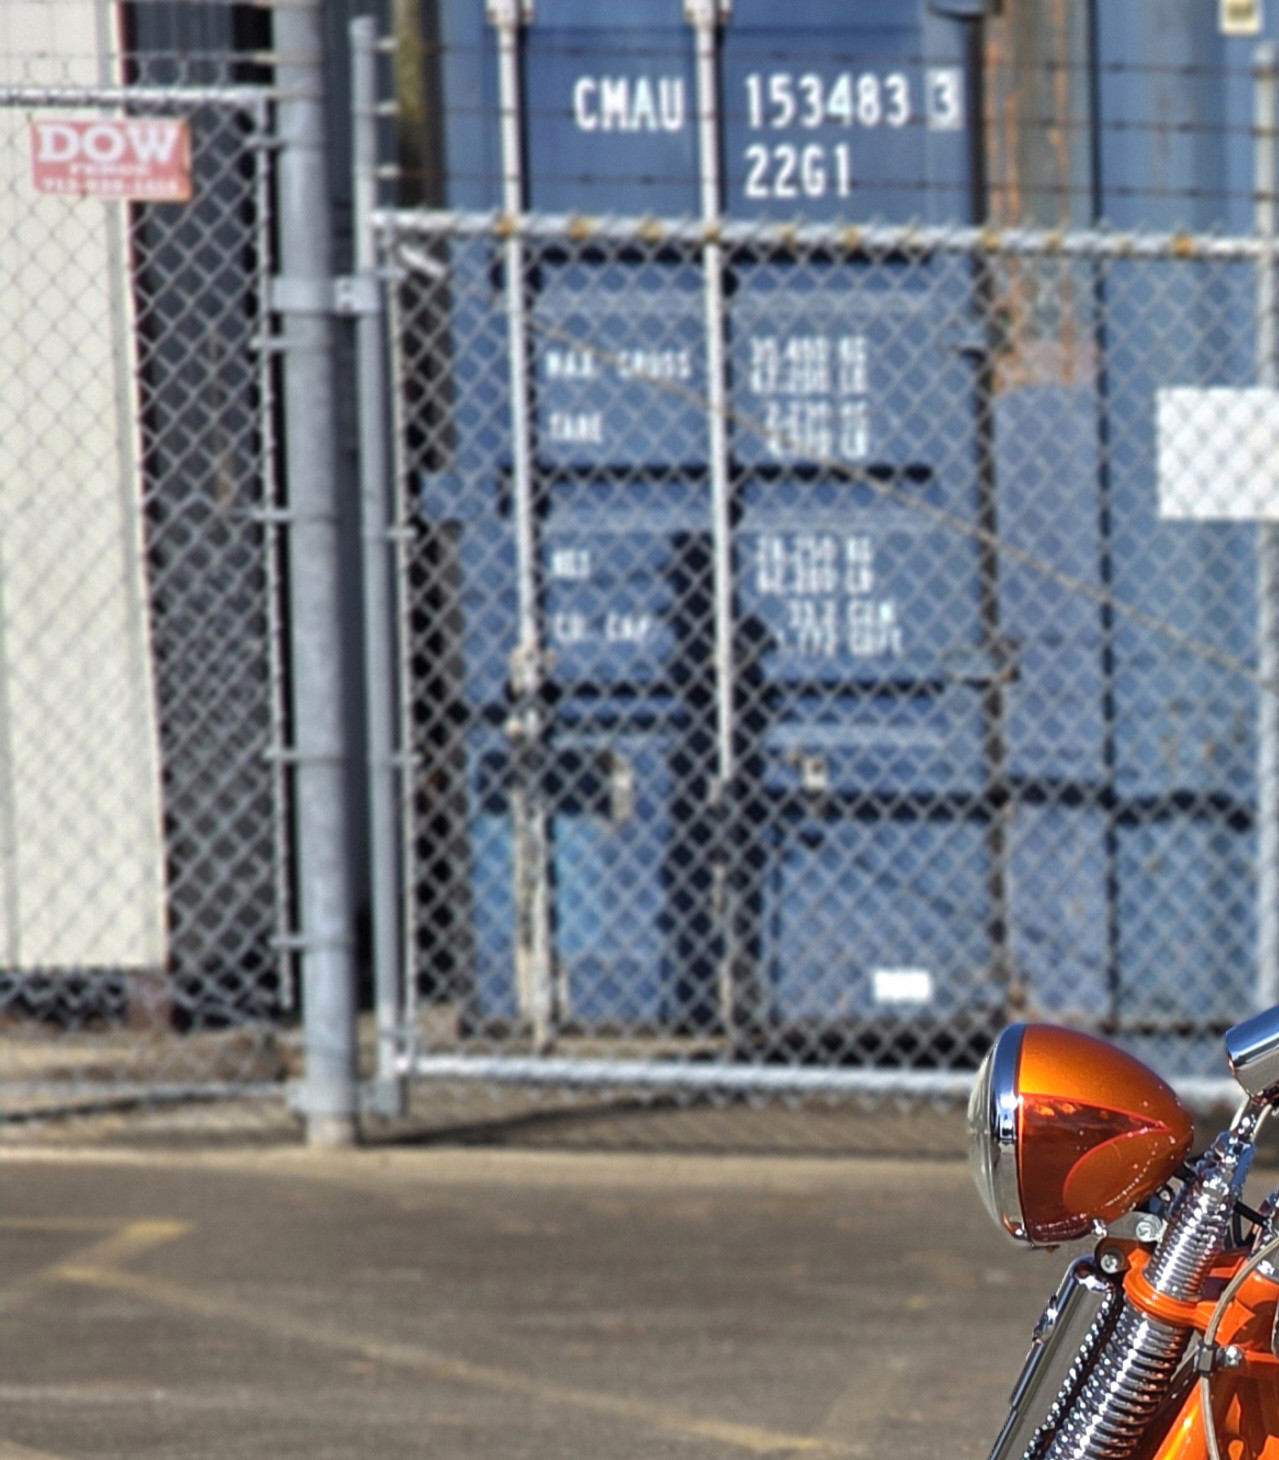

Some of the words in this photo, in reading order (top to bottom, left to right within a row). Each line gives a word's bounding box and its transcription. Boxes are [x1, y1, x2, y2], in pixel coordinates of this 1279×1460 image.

[573, 76, 686, 131] CMAU
[745, 73, 910, 130] 153483
[932, 72, 960, 128] 3
[38, 124, 178, 164] DOW
[744, 143, 851, 198] 22G1
